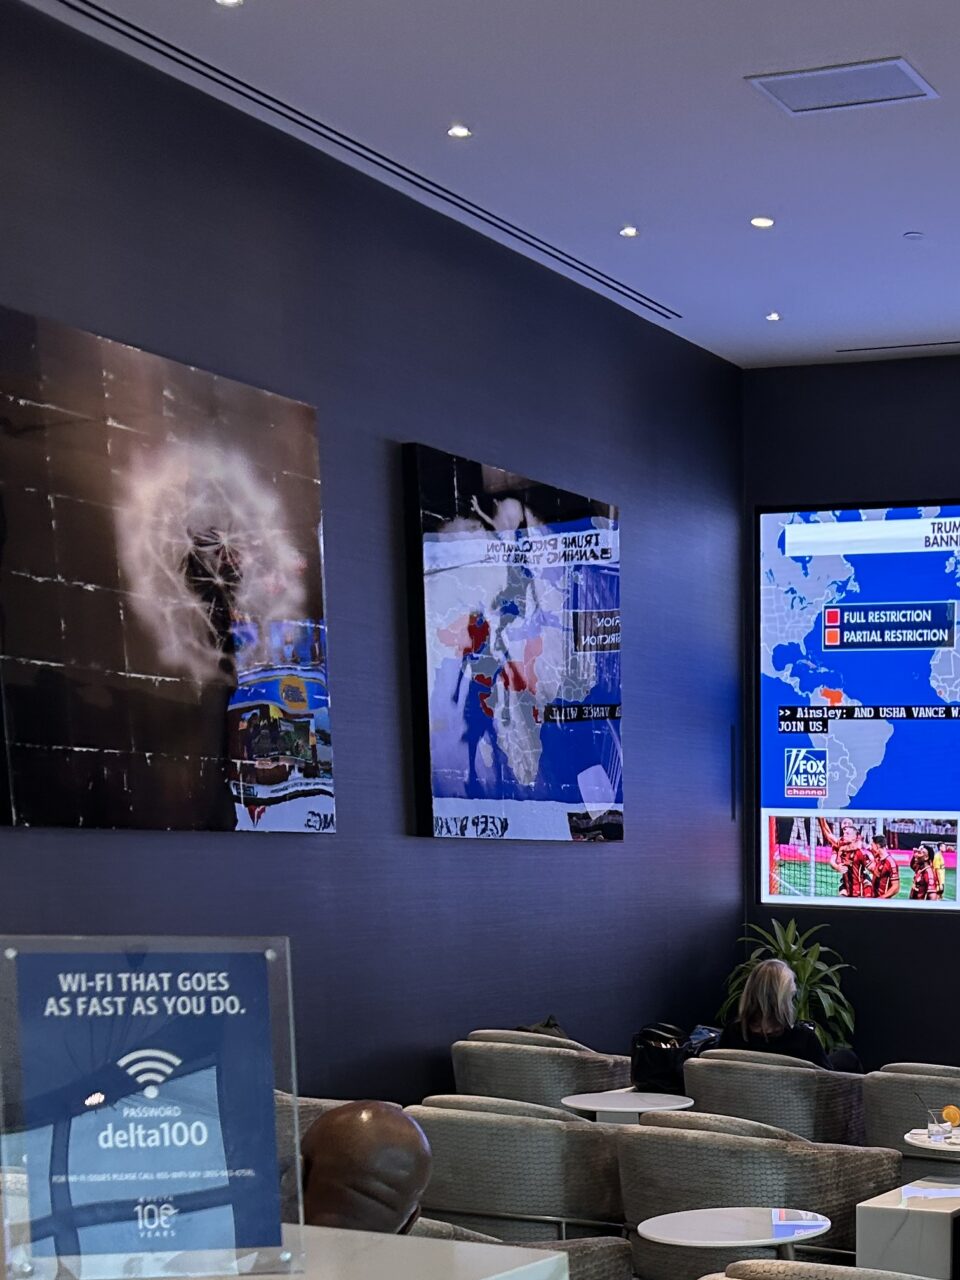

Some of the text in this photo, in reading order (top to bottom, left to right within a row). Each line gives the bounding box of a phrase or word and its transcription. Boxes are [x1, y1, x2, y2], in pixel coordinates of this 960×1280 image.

[844, 609, 932, 624] FULL RESTRICTION
[844, 629, 948, 643] PARTIAL RESTRICTION
[796, 708, 847, 720] Ainsley:
[854, 708, 874, 718] AND
[879, 708, 907, 718] USHA
[912, 707, 946, 718] VANCE
[778, 722, 828, 732] JOIN US.
[799, 760, 825, 773] FOX
[792, 774, 826, 786] NEWS
[787, 788, 826, 796] channel
[58, 972, 229, 992] WI-FI THAT GOES
[44, 996, 246, 1016] AS FAST AS YOU DO.
[123, 1106, 182, 1118] PASSWORD
[98, 1121, 208, 1149] delta100
